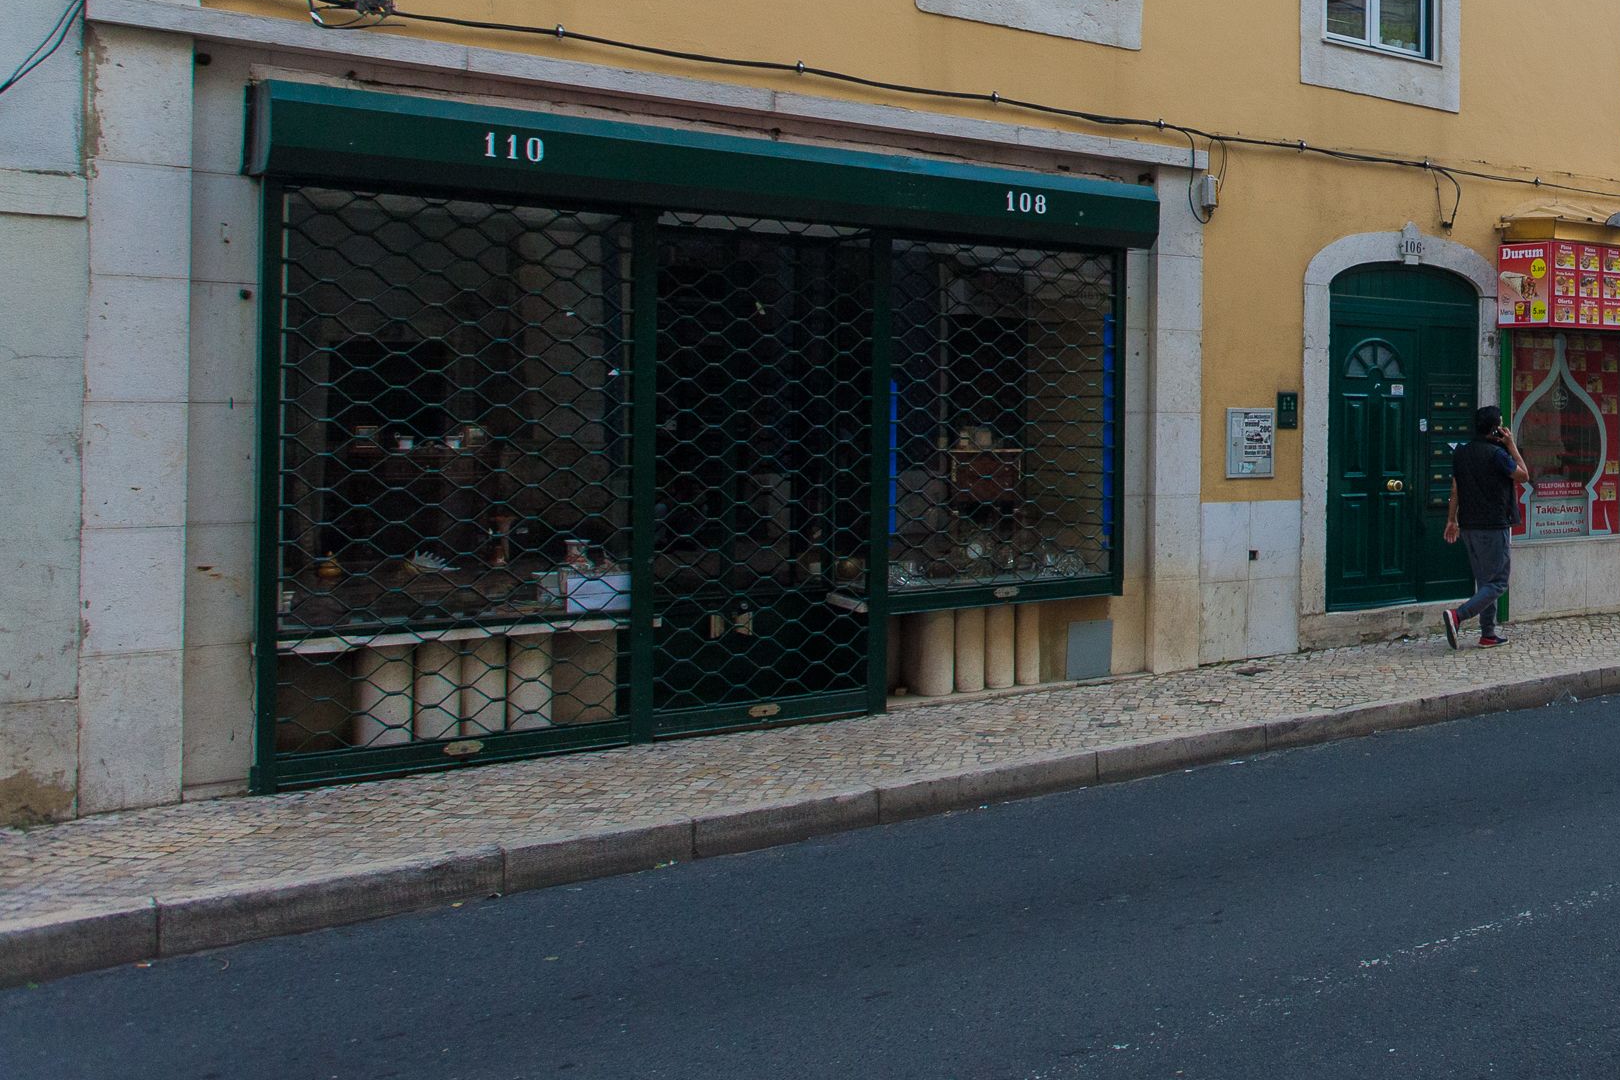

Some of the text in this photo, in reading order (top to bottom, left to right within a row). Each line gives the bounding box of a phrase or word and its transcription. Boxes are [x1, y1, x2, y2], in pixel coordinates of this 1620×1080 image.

[484, 132, 544, 162] 110
[1007, 191, 1047, 214] 108
[1405, 240, 1422, 254] 106
[1502, 248, 1544, 260] Durum
[1535, 504, 1584, 514] Take-Away
